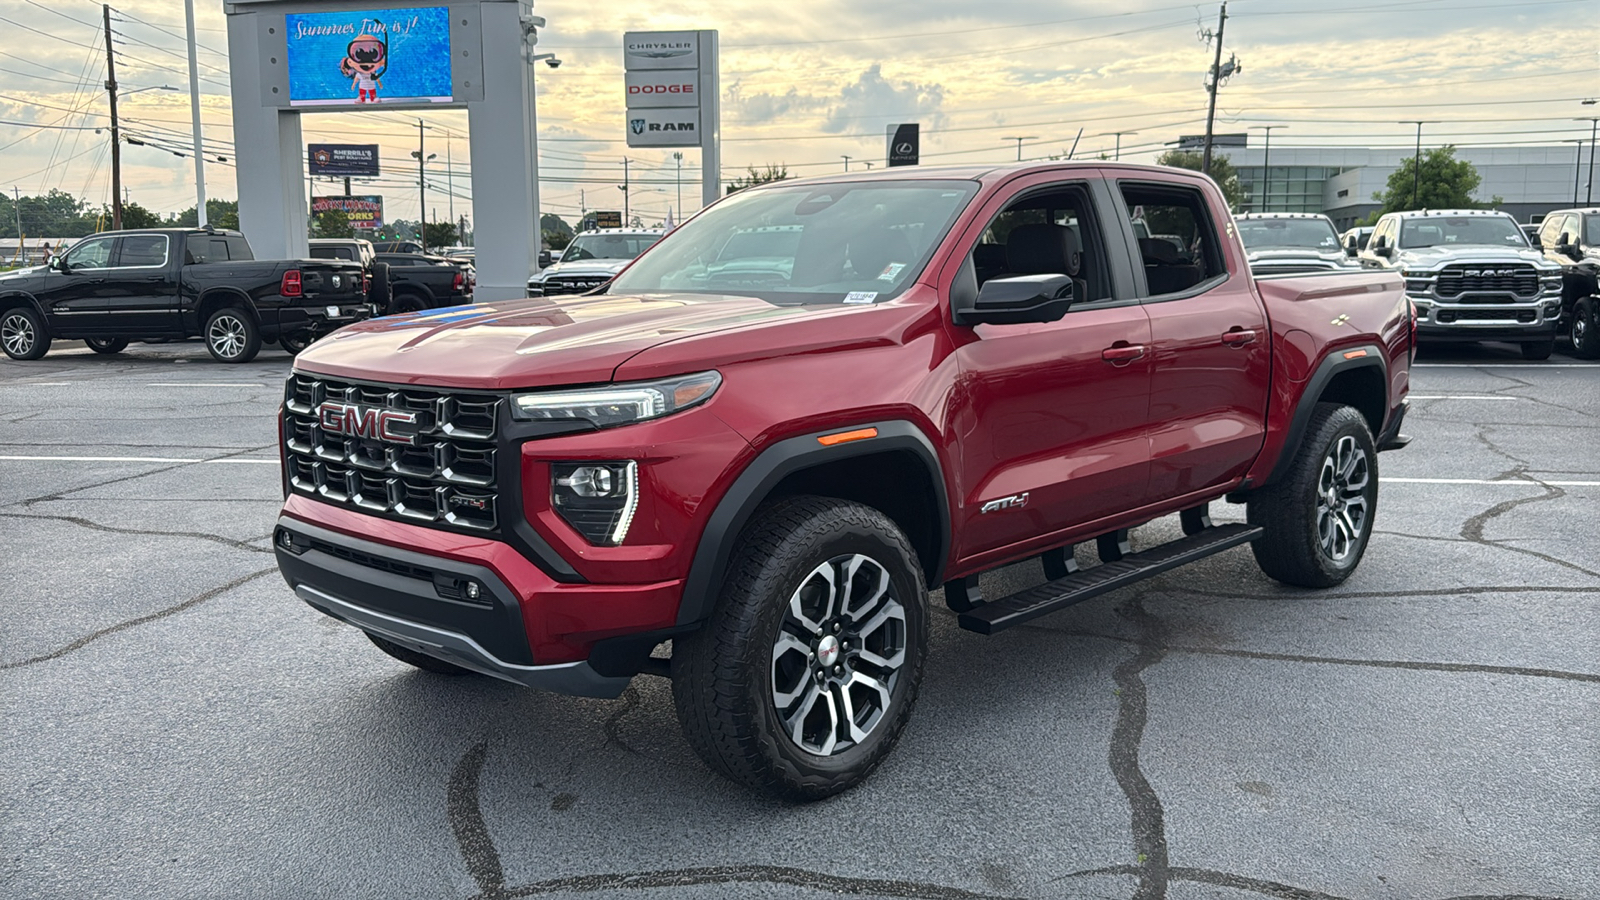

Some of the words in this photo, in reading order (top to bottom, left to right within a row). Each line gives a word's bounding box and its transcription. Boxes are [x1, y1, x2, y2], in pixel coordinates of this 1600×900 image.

[294, 21, 356, 40] Summer
[358, 18, 387, 36] Fun
[628, 42, 692, 50] CHRYSLER
[628, 84, 694, 94] DODGE
[648, 122, 695, 131] RAM
[312, 200, 344, 211] WACKY
[1464, 269, 1513, 277] RAM
[562, 281, 601, 289] RAM
[319, 402, 416, 445] GMC
[981, 492, 1029, 514] AT4
